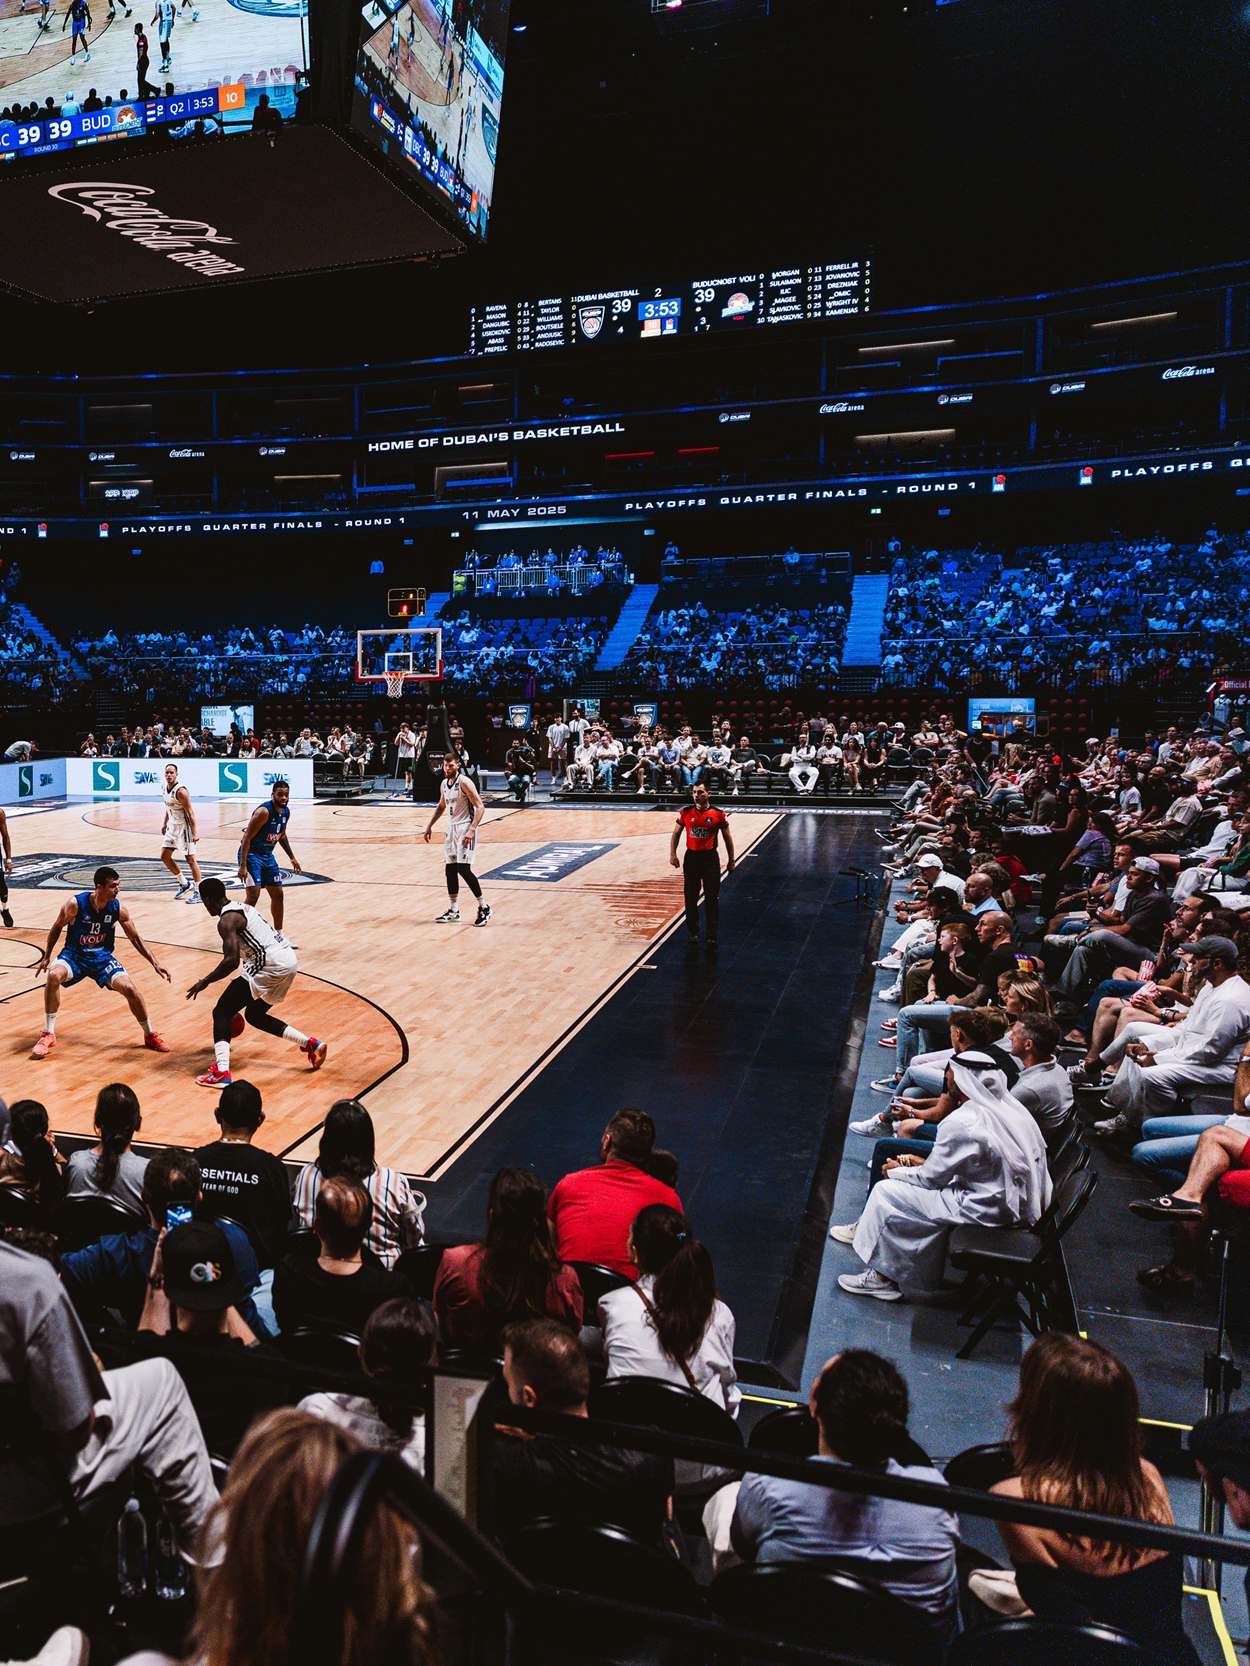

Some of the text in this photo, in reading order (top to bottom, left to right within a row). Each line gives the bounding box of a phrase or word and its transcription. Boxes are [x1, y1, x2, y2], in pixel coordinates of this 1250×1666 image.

[226, 92, 238, 104] 10
[157, 105, 164, 116] TO
[170, 97, 214, 115] Q2 3:53
[82, 115, 111, 132] BUD
[50, 119, 72, 139] 39
[18, 126, 40, 145] 39
[34, 144, 50, 152] ROUND
[423, 147, 431, 166] 39
[431, 155, 439, 174] 39
[48, 182, 245, 276] Coca-Cola arena
[825, 263, 850, 271] FERRELL
[772, 269, 800, 279] MORGAN
[825, 271, 860, 280] JOVANOVIC
[692, 275, 756, 288] BUDUCNOST VOLI
[769, 278, 802, 287] SULAIMON
[827, 280, 858, 289] DREZNJAK
[577, 289, 640, 302] DUBAI BASKETBALL
[655, 288, 662, 297] 2
[694, 288, 715, 303] 39
[538, 298, 562, 306] BERTANS
[774, 296, 797, 304] MAGEE
[826, 298, 851, 307] WRIGHT
[612, 299, 631, 313] 39
[645, 301, 678, 317] 3:53
[769, 305, 801, 313] SLAVKOVIC
[826, 307, 858, 316] KAMENJAS
[537, 315, 563, 323] WILLIAMS
[700, 317, 706, 325] 3
[767, 313, 804, 322] TANASKOVIC
[482, 321, 510, 329] DANGUBIC
[536, 323, 564, 331] BOUTSIELE
[482, 329, 511, 337] USKOKOVIC
[537, 331, 563, 339] ANDJUSIC
[535, 340, 565, 348] RADOSEVIC
[484, 345, 508, 353] PREPELIC
[1162, 365, 1215, 379] Coca-Cola arena
[819, 402, 849, 413] Coca-Cola
[369, 423, 625, 451] HOME OF DUBAI'S BASKETBALL
[169, 449, 193, 458] Coca-Cola
[1112, 462, 1212, 477] PLAYOFFS
[626, 499, 705, 509] PLAYOFFS
[721, 493, 796, 504] QUARTER
[806, 489, 866, 498] FINALS
[897, 483, 957, 493] ROUND
[488, 509, 519, 517] MAY
[528, 506, 566, 515] 2025
[1224, 680, 1247, 689] Official
[277, 824, 281, 833] 0
[502, 845, 605, 879] ADMIRAL
[90, 922, 101, 935] 13
[82, 935, 105, 943] VOLI
[110, 960, 122, 969] 13
[199, 1168, 259, 1184] SENTIALS
[202, 1183, 217, 1191] FEAR
[227, 1186, 239, 1194] GOD
